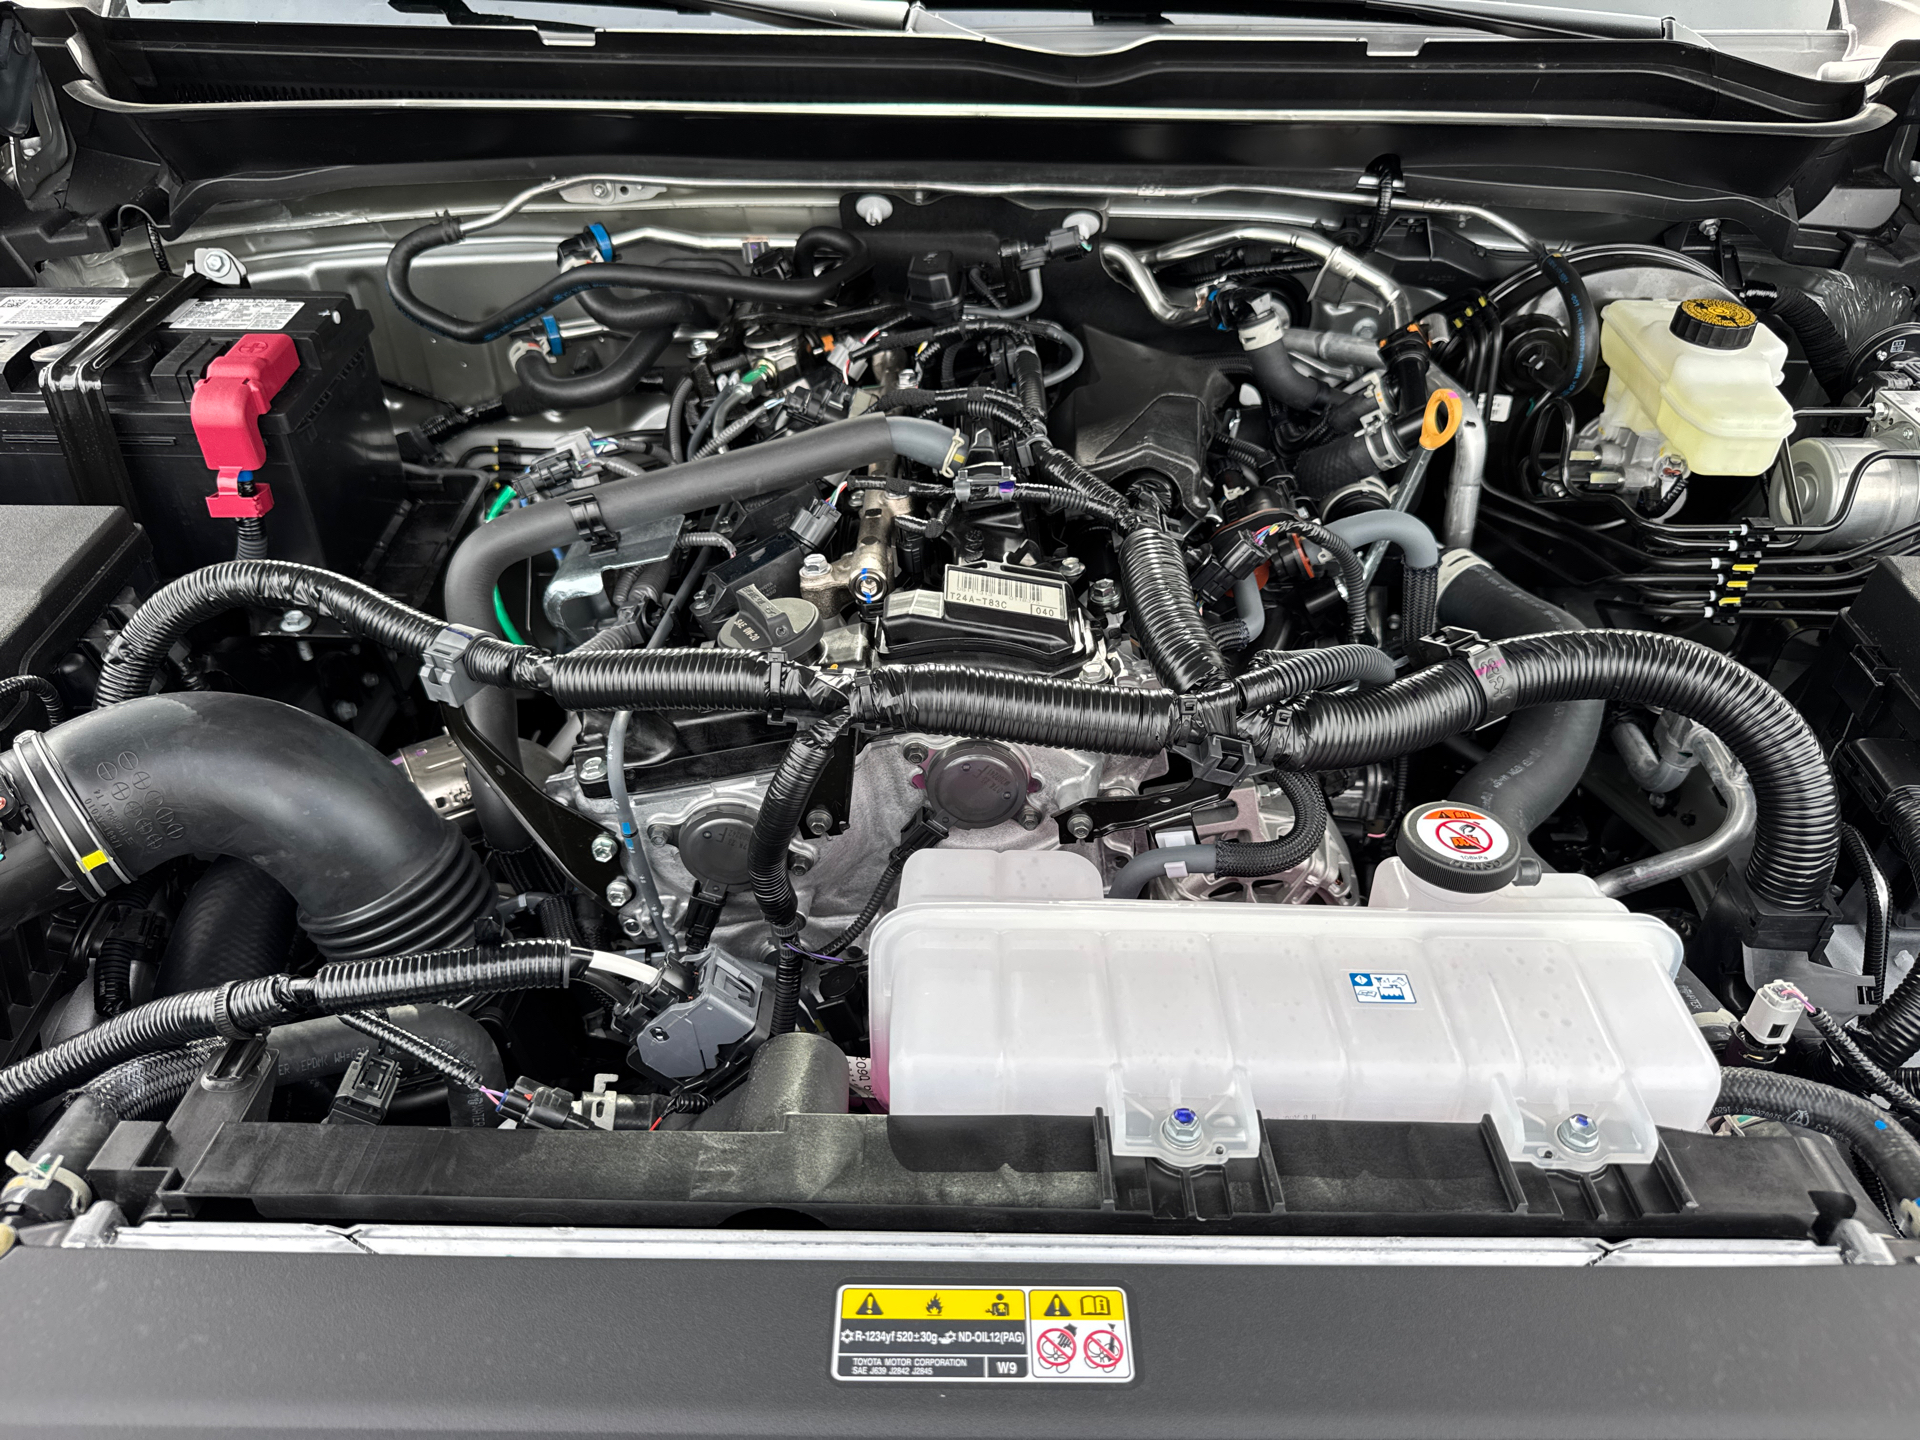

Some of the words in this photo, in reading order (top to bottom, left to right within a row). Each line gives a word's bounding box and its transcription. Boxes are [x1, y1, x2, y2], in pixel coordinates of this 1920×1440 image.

[950, 592, 1008, 609] T24A-T83C
[1036, 607, 1055, 617] 040
[1450, 859, 1502, 870] DENSO
[855, 1331, 895, 1344] R-1234yf
[896, 1331, 938, 1344] 520±30g
[958, 1331, 1025, 1345] ND-OIL12(PAG)
[852, 1357, 882, 1366] TOYOTA
[884, 1358, 912, 1366] MOTOR
[914, 1358, 967, 1367] CORPORATION
[852, 1366, 868, 1375] SAE
[869, 1367, 887, 1375] J639
[889, 1367, 910, 1375] J2842
[911, 1367, 934, 1375] J2845
[997, 1361, 1018, 1375] W9
